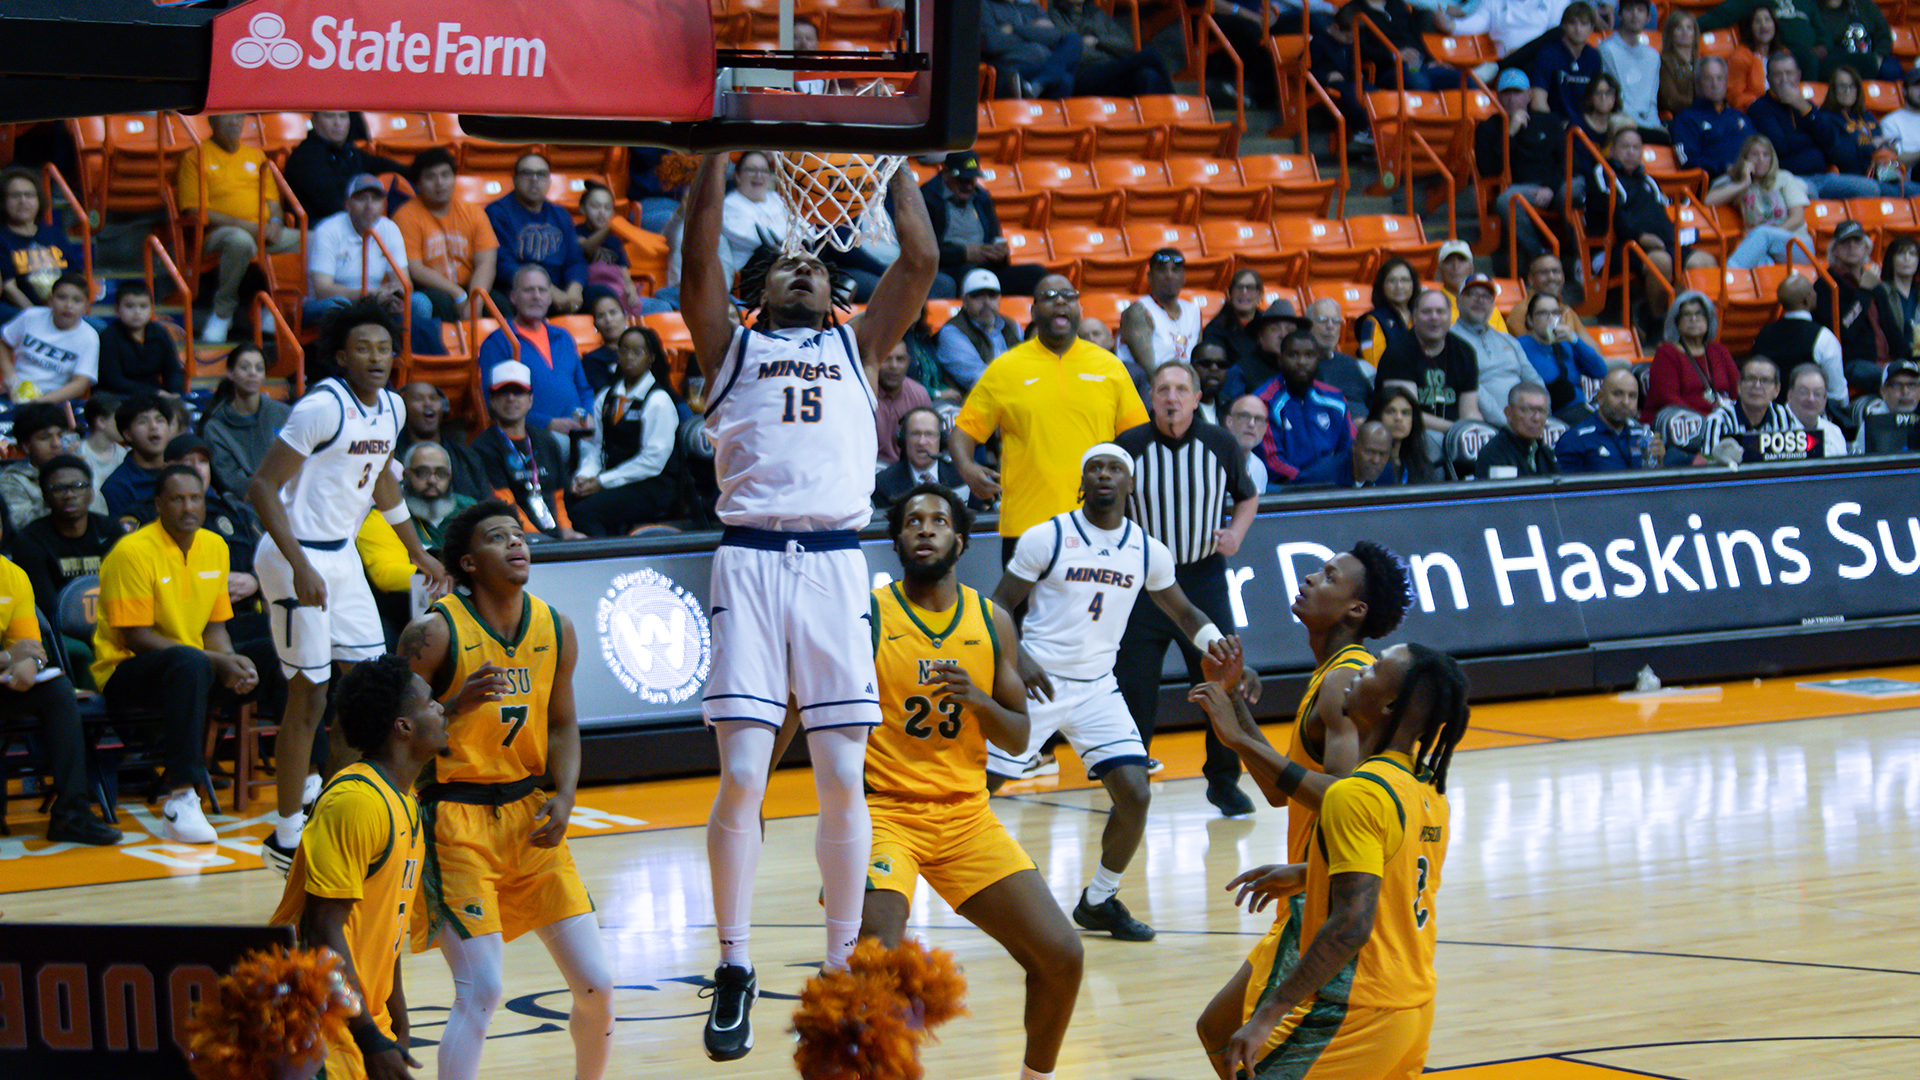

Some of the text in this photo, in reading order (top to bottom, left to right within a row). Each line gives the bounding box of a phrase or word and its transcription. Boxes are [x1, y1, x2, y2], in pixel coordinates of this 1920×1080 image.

[757, 360, 842, 381] MINERS
[781, 385, 823, 424] 15
[337, 439, 391, 455] MINERS
[1760, 430, 1808, 454] POSS
[356, 462, 373, 490] 3
[1483, 512, 1812, 607] Haskins
[1064, 567, 1134, 589] MINERS
[1087, 591, 1105, 622] 4
[500, 704, 529, 748] 7
[904, 695, 966, 740] 23
